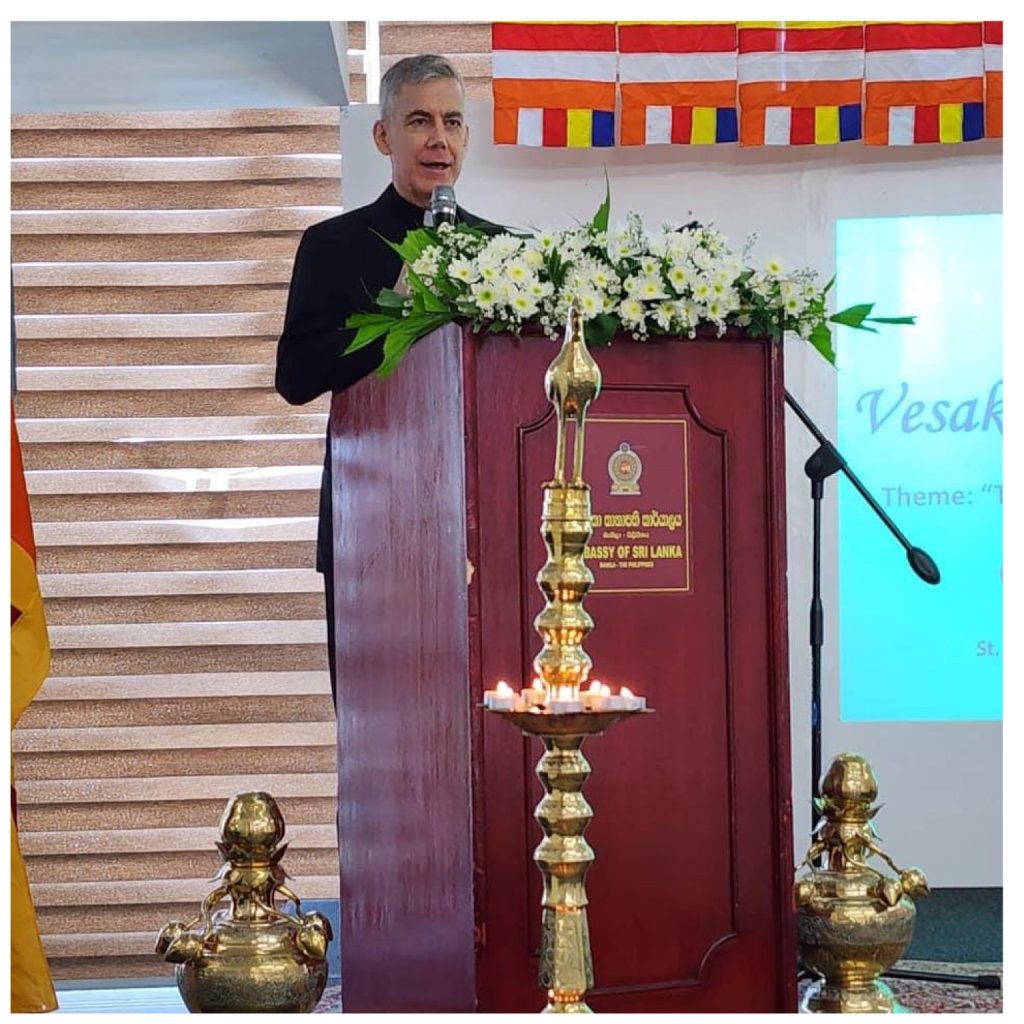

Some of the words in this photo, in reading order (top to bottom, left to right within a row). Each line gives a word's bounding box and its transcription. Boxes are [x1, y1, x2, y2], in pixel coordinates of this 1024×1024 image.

[881, 486, 973, 508] Theme:
[584, 545, 615, 559] BASSY
[617, 545, 630, 559] OF
[632, 545, 648, 559] SRI
[650, 545, 682, 559] LANKA
[976, 640, 1000, 657] St.
